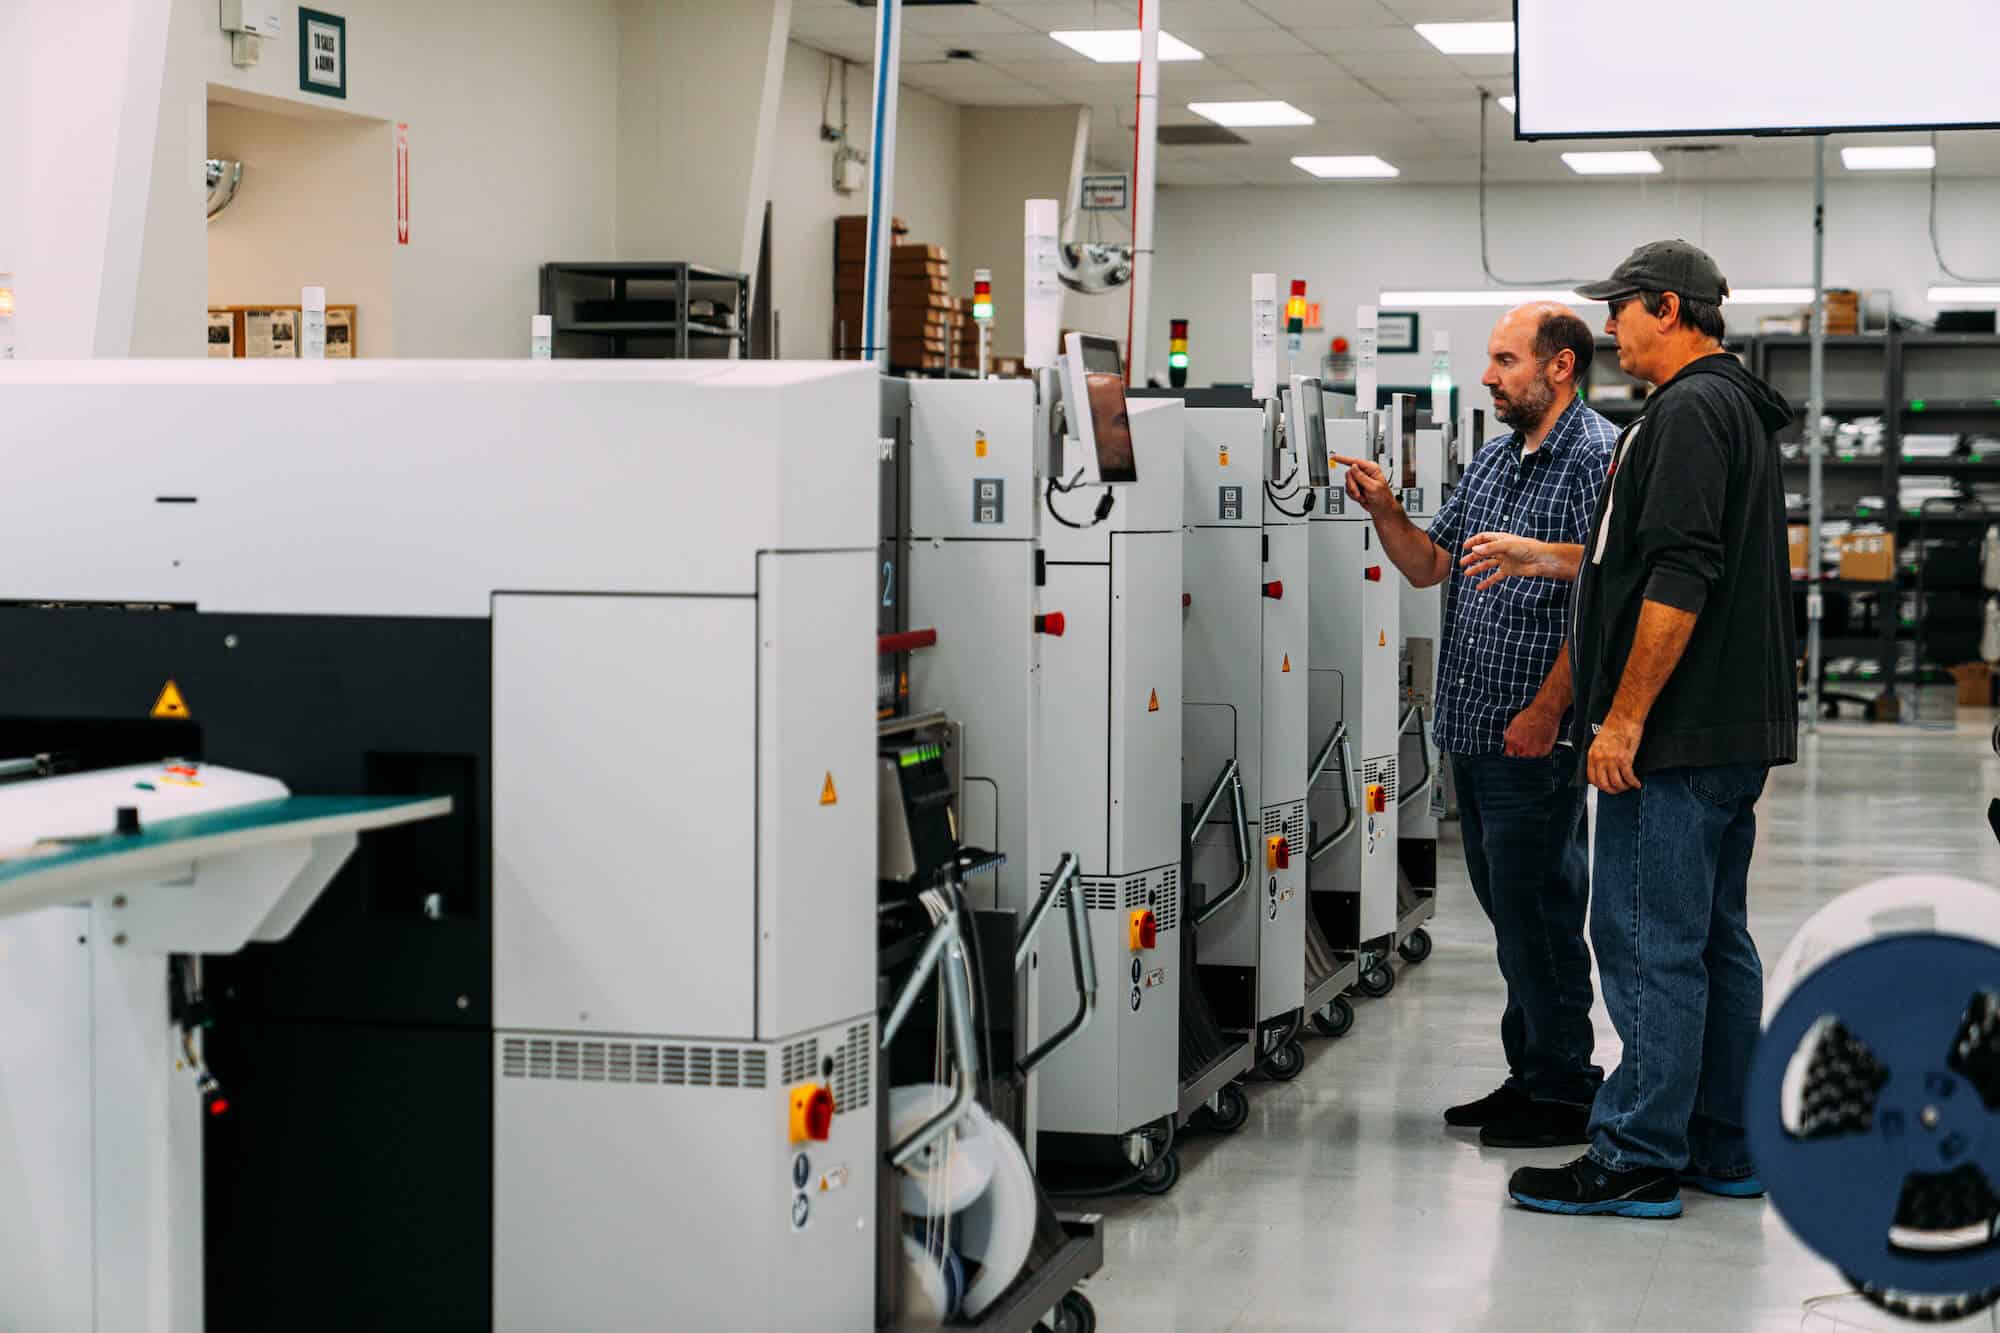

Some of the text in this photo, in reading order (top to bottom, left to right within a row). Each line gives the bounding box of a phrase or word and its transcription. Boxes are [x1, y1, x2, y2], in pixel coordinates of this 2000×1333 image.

[314, 32, 335, 53] TO SALES
[315, 55, 335, 73] & ADMIN
[882, 561, 892, 606] 2
